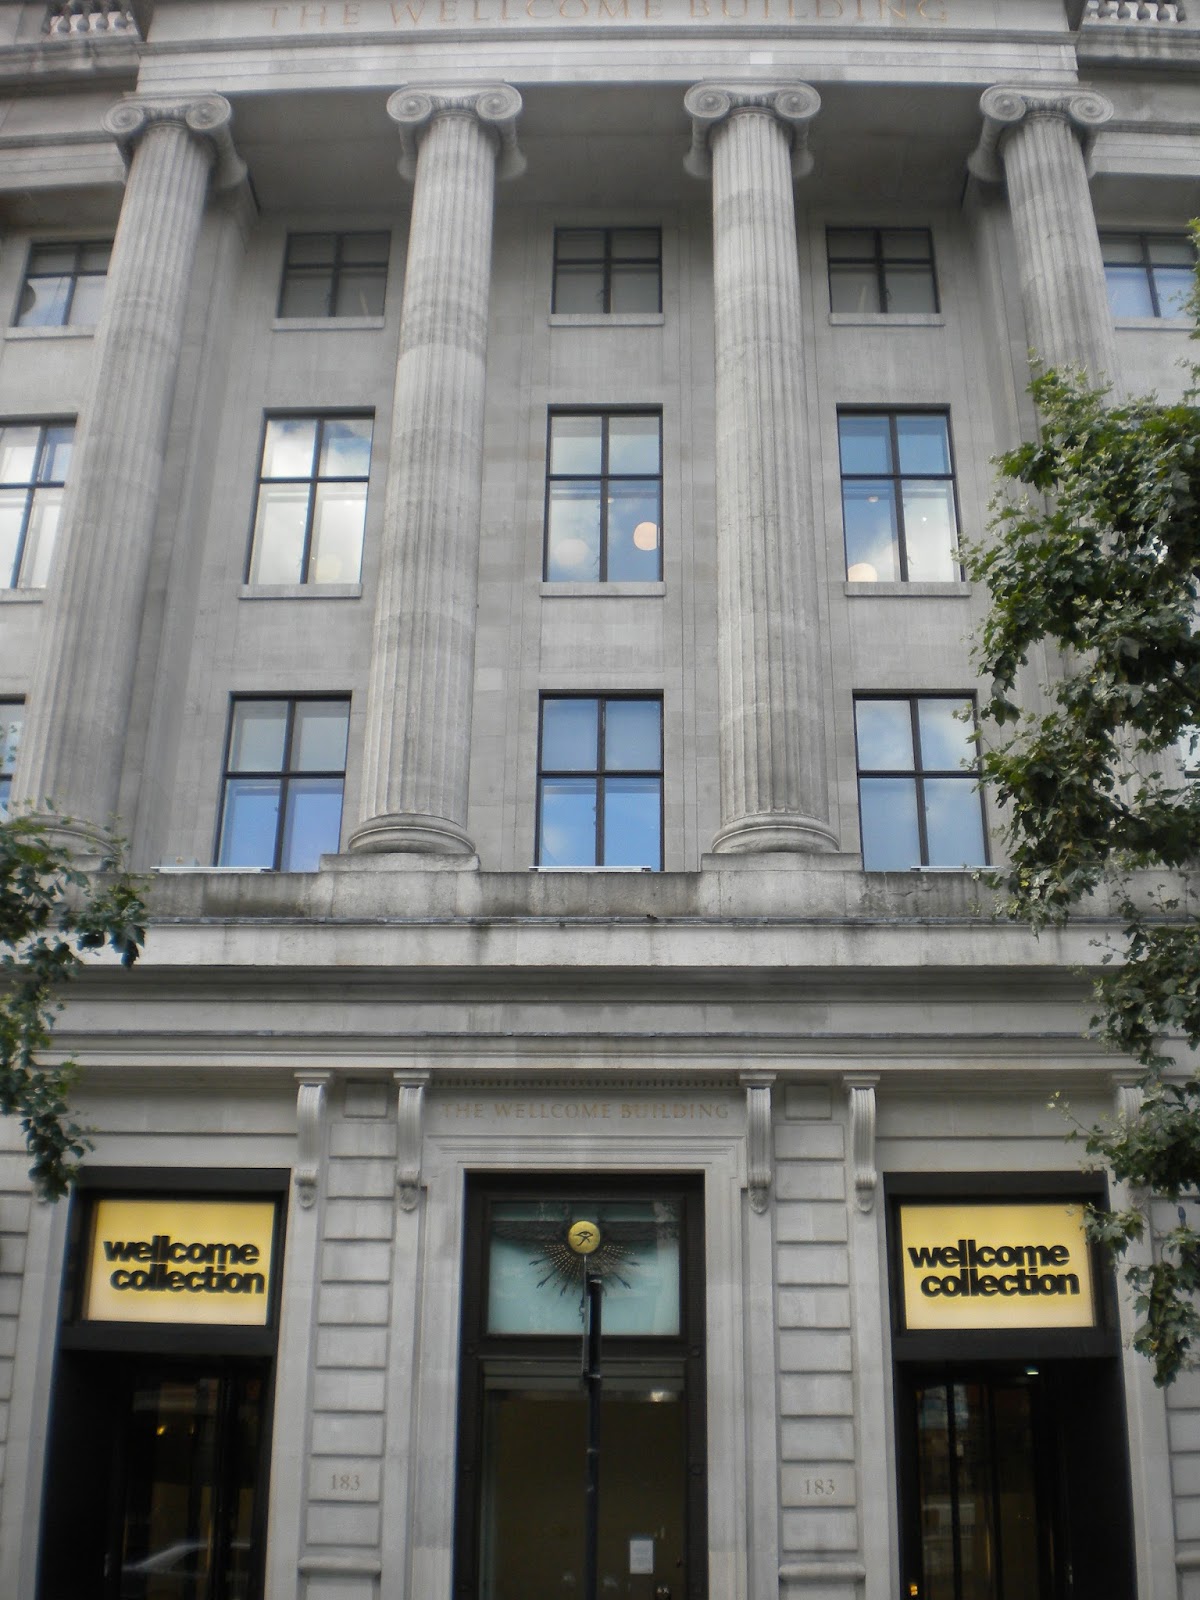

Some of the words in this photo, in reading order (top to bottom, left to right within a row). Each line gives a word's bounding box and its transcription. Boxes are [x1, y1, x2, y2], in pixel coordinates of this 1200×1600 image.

[263, 4, 361, 29] THE
[388, 0, 663, 25] WELLCOME
[689, 0, 948, 21] BUILDING
[441, 1103, 484, 1119] THE
[494, 1103, 612, 1119] WELLCOME
[620, 1103, 729, 1119] BUILDING
[103, 1235, 259, 1265] wellcome
[907, 1239, 1070, 1268] wellcome
[110, 1263, 265, 1294] collection
[920, 1267, 1080, 1297] collection
[330, 1473, 361, 1491] 183
[803, 1478, 835, 1495] 183
